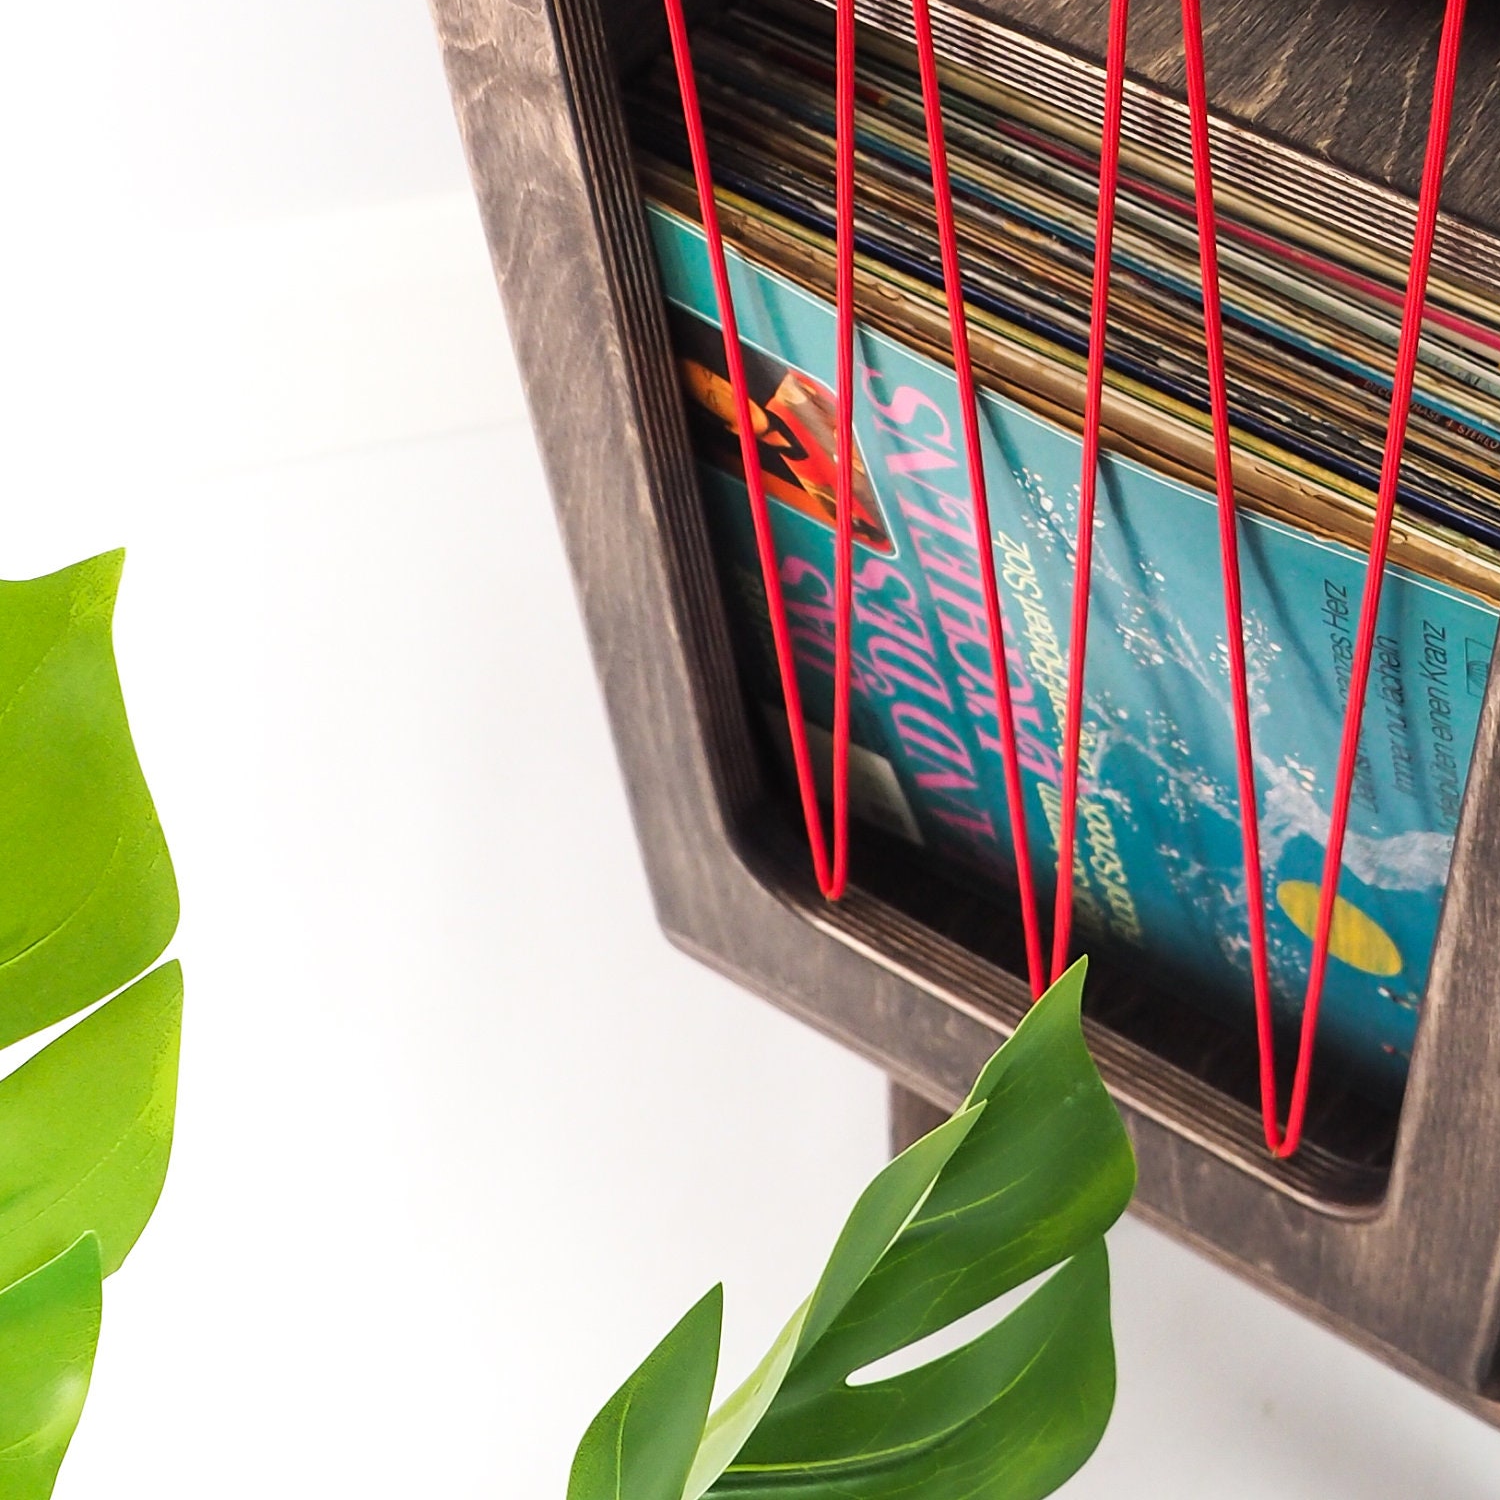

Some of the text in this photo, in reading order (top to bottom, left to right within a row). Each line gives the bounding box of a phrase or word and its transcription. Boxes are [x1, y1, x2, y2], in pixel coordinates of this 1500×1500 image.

[1362, 380, 1395, 402] DECC
[1455, 424, 1499, 450] STEREO
[860, 368, 1064, 780] LÄCHELNS
[989, 526, 1041, 599] Stolz
[774, 550, 888, 698] DAS
[848, 548, 950, 709] DES
[1011, 591, 1067, 685] Robert
[1322, 578, 1350, 633] Herz
[1420, 618, 1446, 686] Kranz
[1427, 685, 1452, 743] einen
[1079, 796, 1128, 883] Schock
